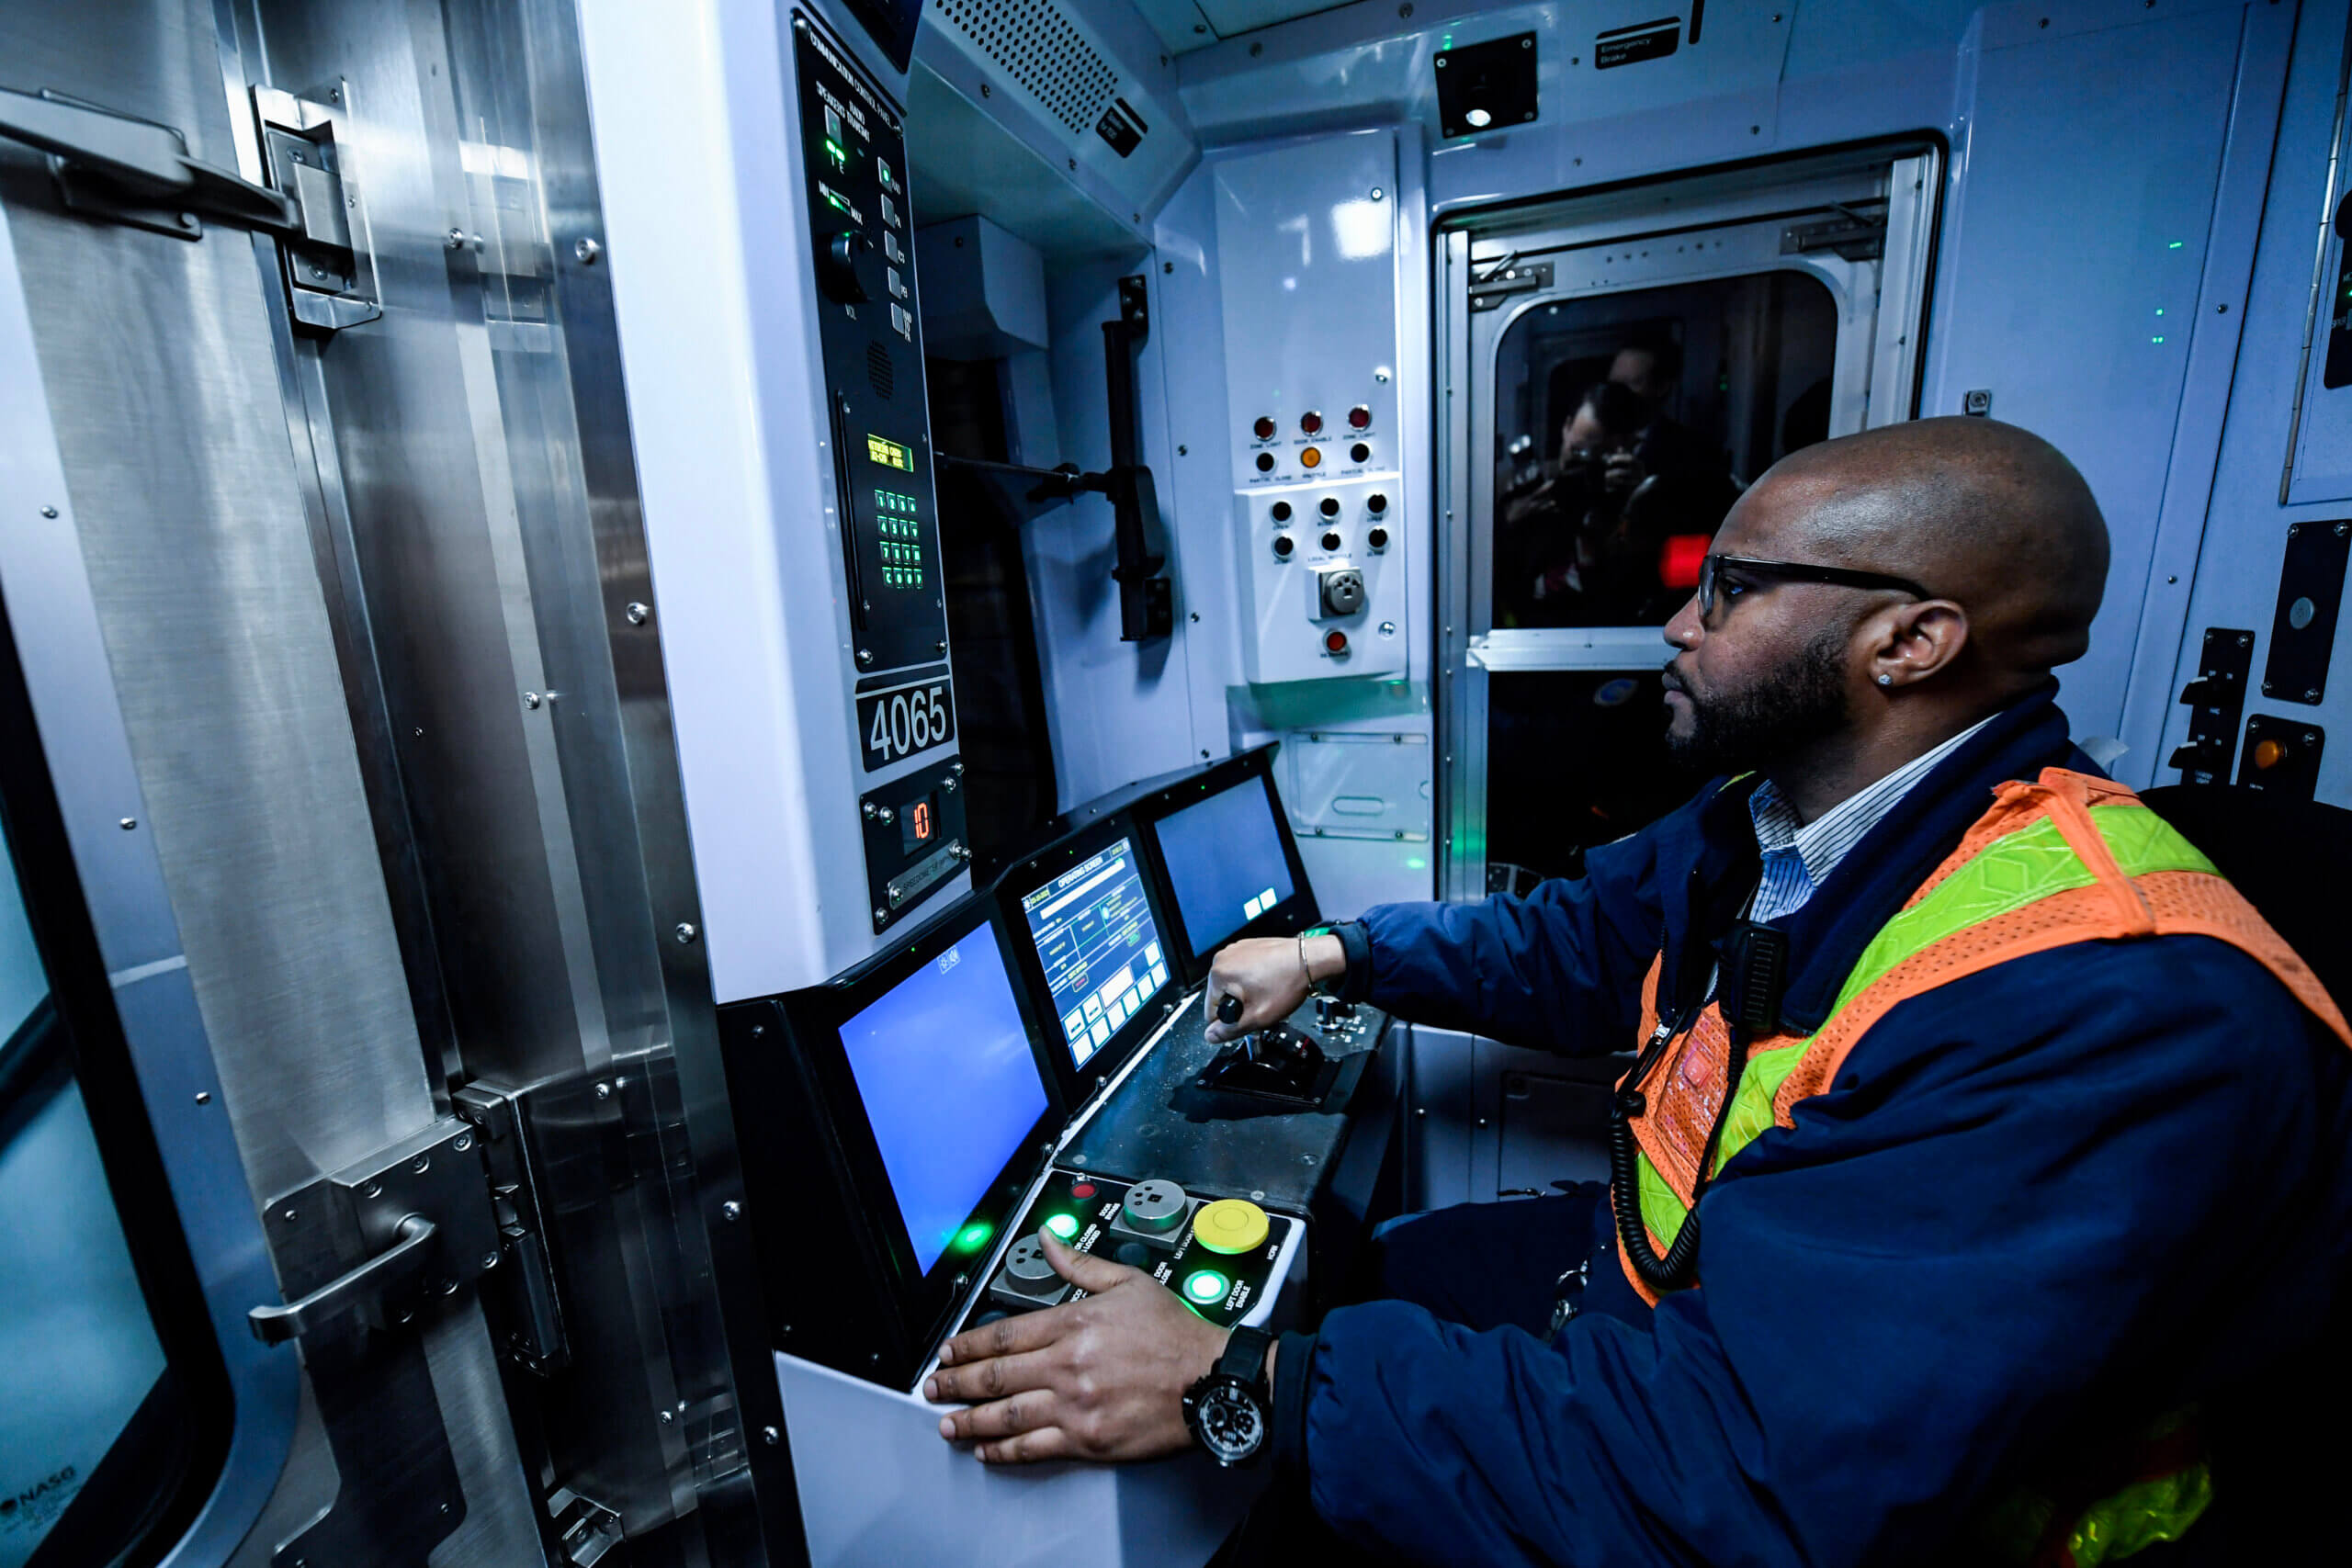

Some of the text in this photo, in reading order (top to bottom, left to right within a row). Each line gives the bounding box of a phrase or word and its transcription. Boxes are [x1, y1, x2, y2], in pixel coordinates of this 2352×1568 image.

[870, 685, 946, 761] 4065
[1057, 855, 1103, 888] OPERATING SCREEN
[1098, 1202, 1113, 1217] DOOR
[1103, 1202, 1121, 1220] BYPASS
[1079, 1223, 1098, 1243] CLOSED
[1083, 1229, 1102, 1250] LOCKED
[1173, 1232, 1194, 1259] LEFT DOOR
[1266, 1244, 1280, 1260] HORN
[1153, 1260, 1169, 1278] DOOR
[1224, 1279, 1245, 1311] LEFT DOOR
[1235, 1285, 1251, 1309] ENABLE
